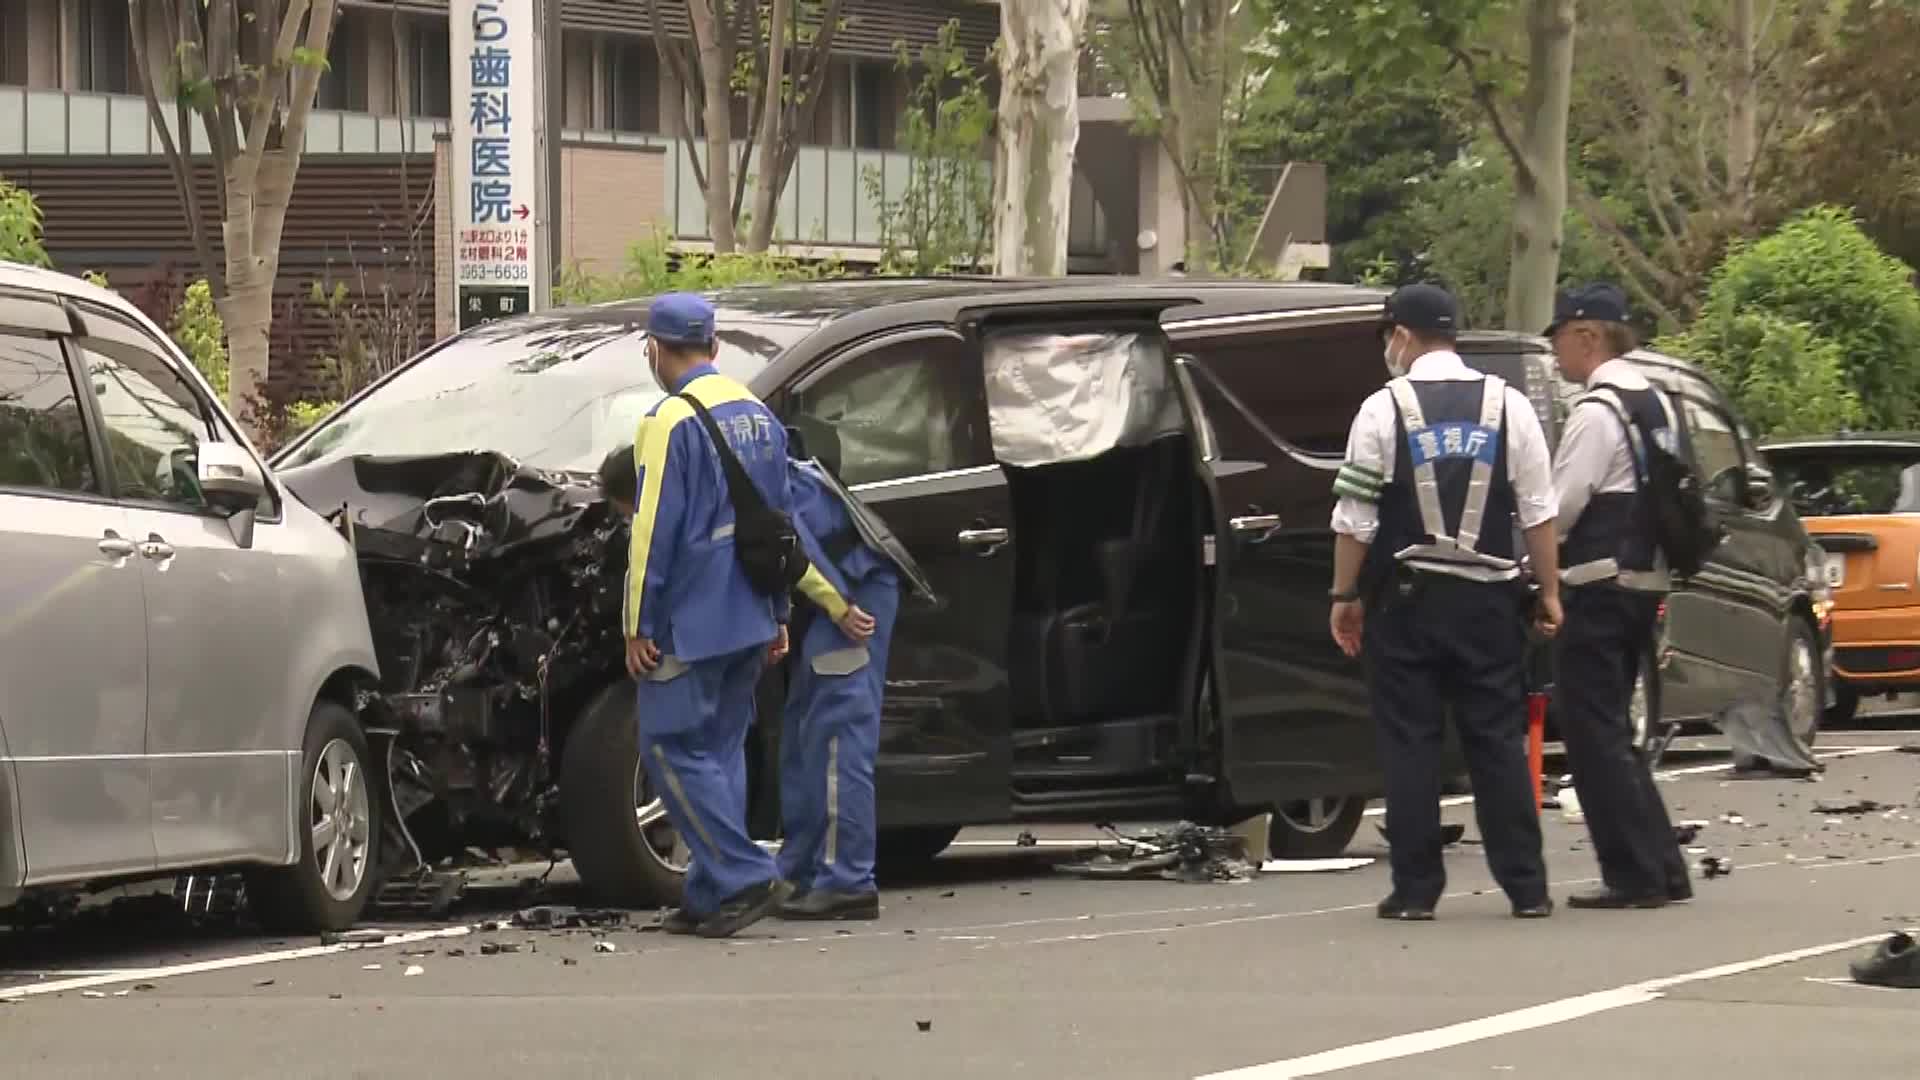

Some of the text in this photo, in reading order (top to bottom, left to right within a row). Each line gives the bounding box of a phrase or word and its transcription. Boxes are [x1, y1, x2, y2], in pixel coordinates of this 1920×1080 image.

[470, 0, 512, 223] ら歯科医院
[1417, 427, 1489, 459] 警視庁
